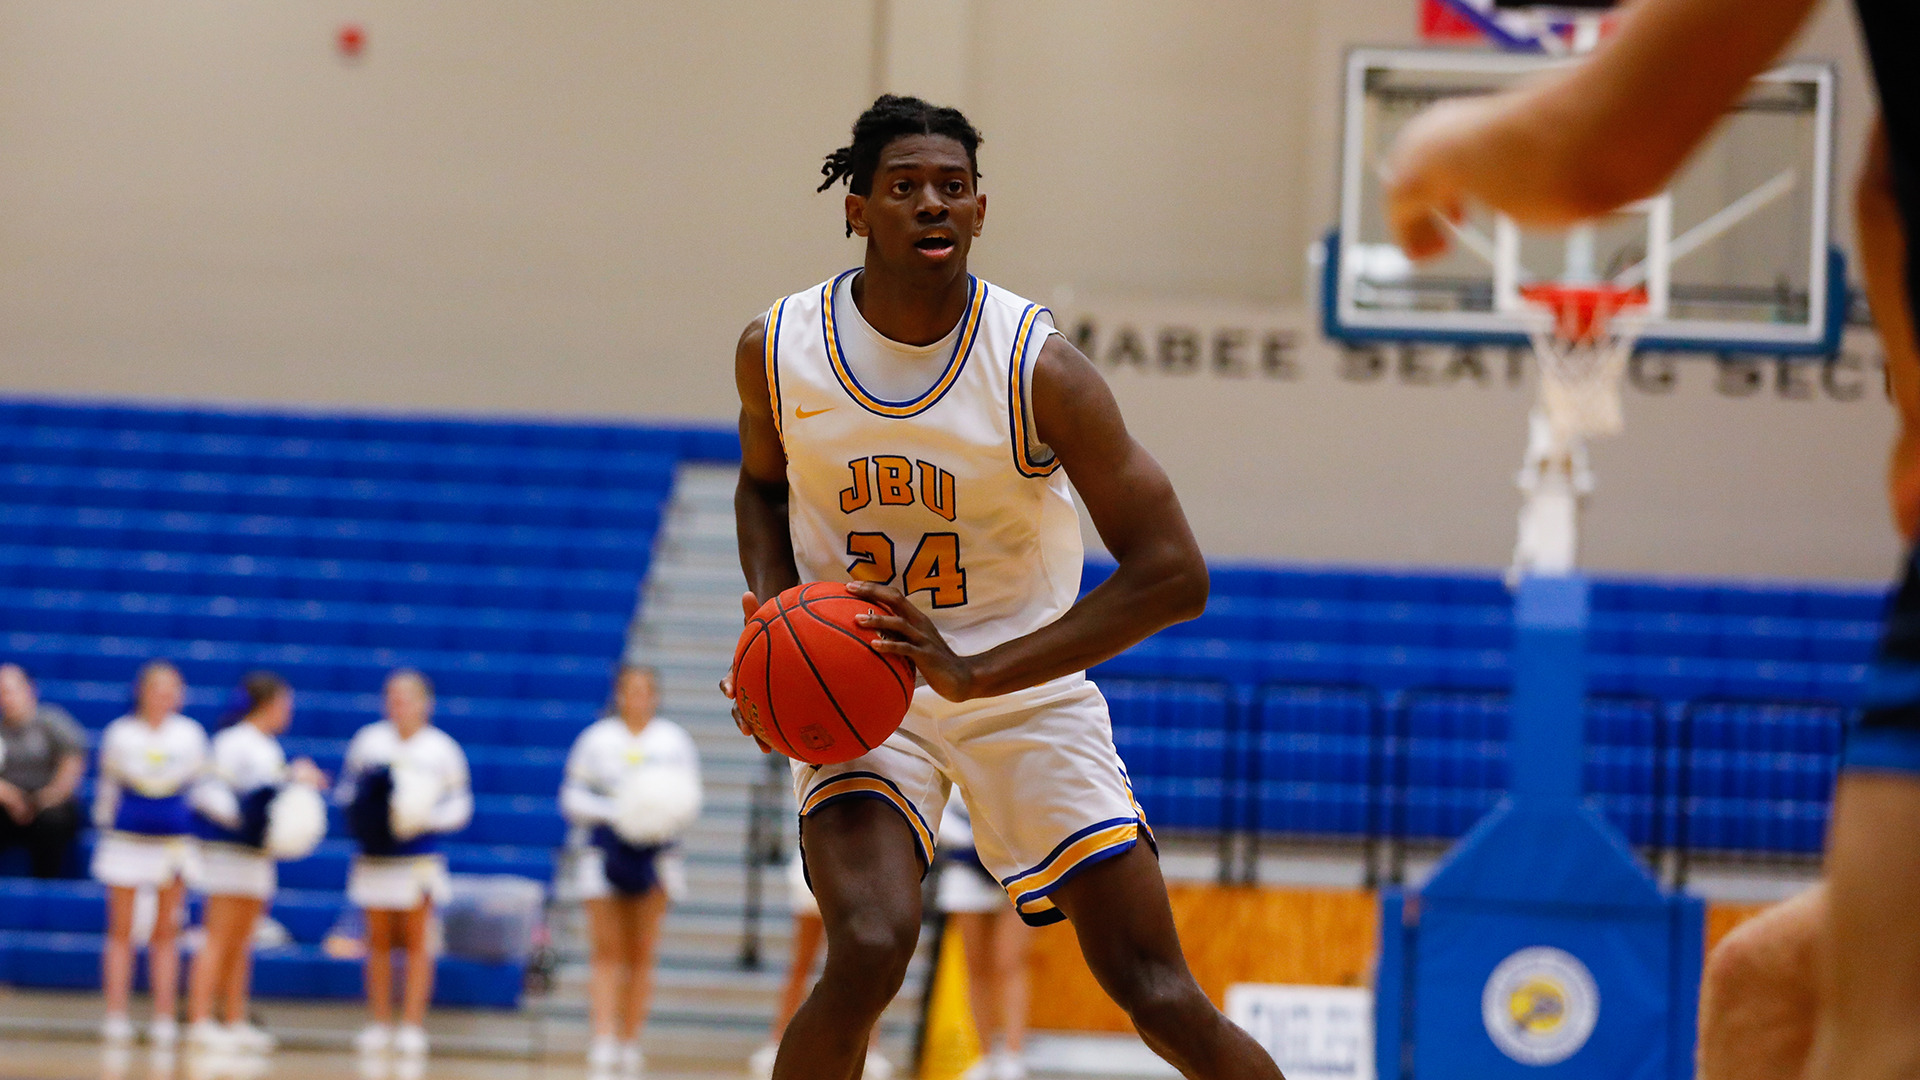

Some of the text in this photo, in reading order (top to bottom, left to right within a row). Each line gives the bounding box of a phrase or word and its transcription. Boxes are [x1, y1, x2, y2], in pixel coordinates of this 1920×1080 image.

[1342, 342, 1676, 393] SEATG
[839, 455, 956, 522] JBU
[846, 531, 967, 608] 24
